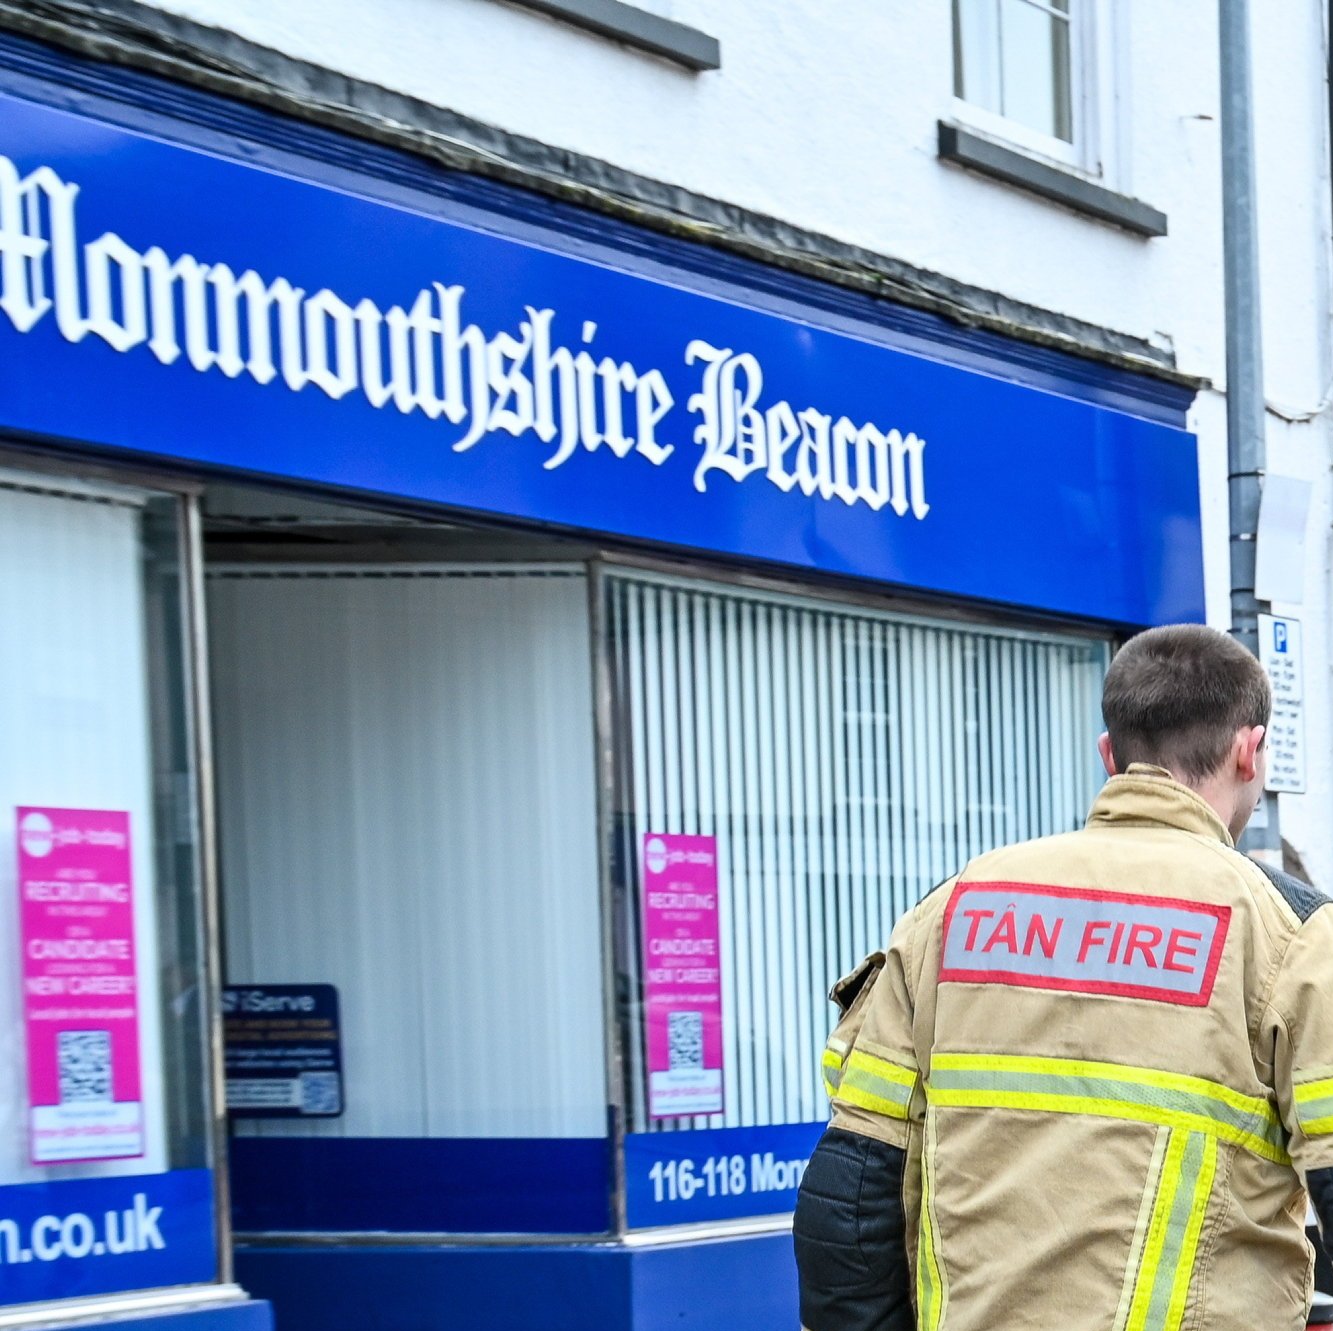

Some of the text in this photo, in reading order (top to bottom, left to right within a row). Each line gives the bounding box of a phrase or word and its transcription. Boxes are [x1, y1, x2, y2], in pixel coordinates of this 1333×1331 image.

[0, 154, 930, 520] Monmouthshire Beacon
[27, 939, 131, 959] CANDIDATE
[650, 939, 715, 955] CANDIDATE
[962, 902, 1203, 974] TÂN FIRE
[649, 1152, 809, 1202] 116-118 Mon
